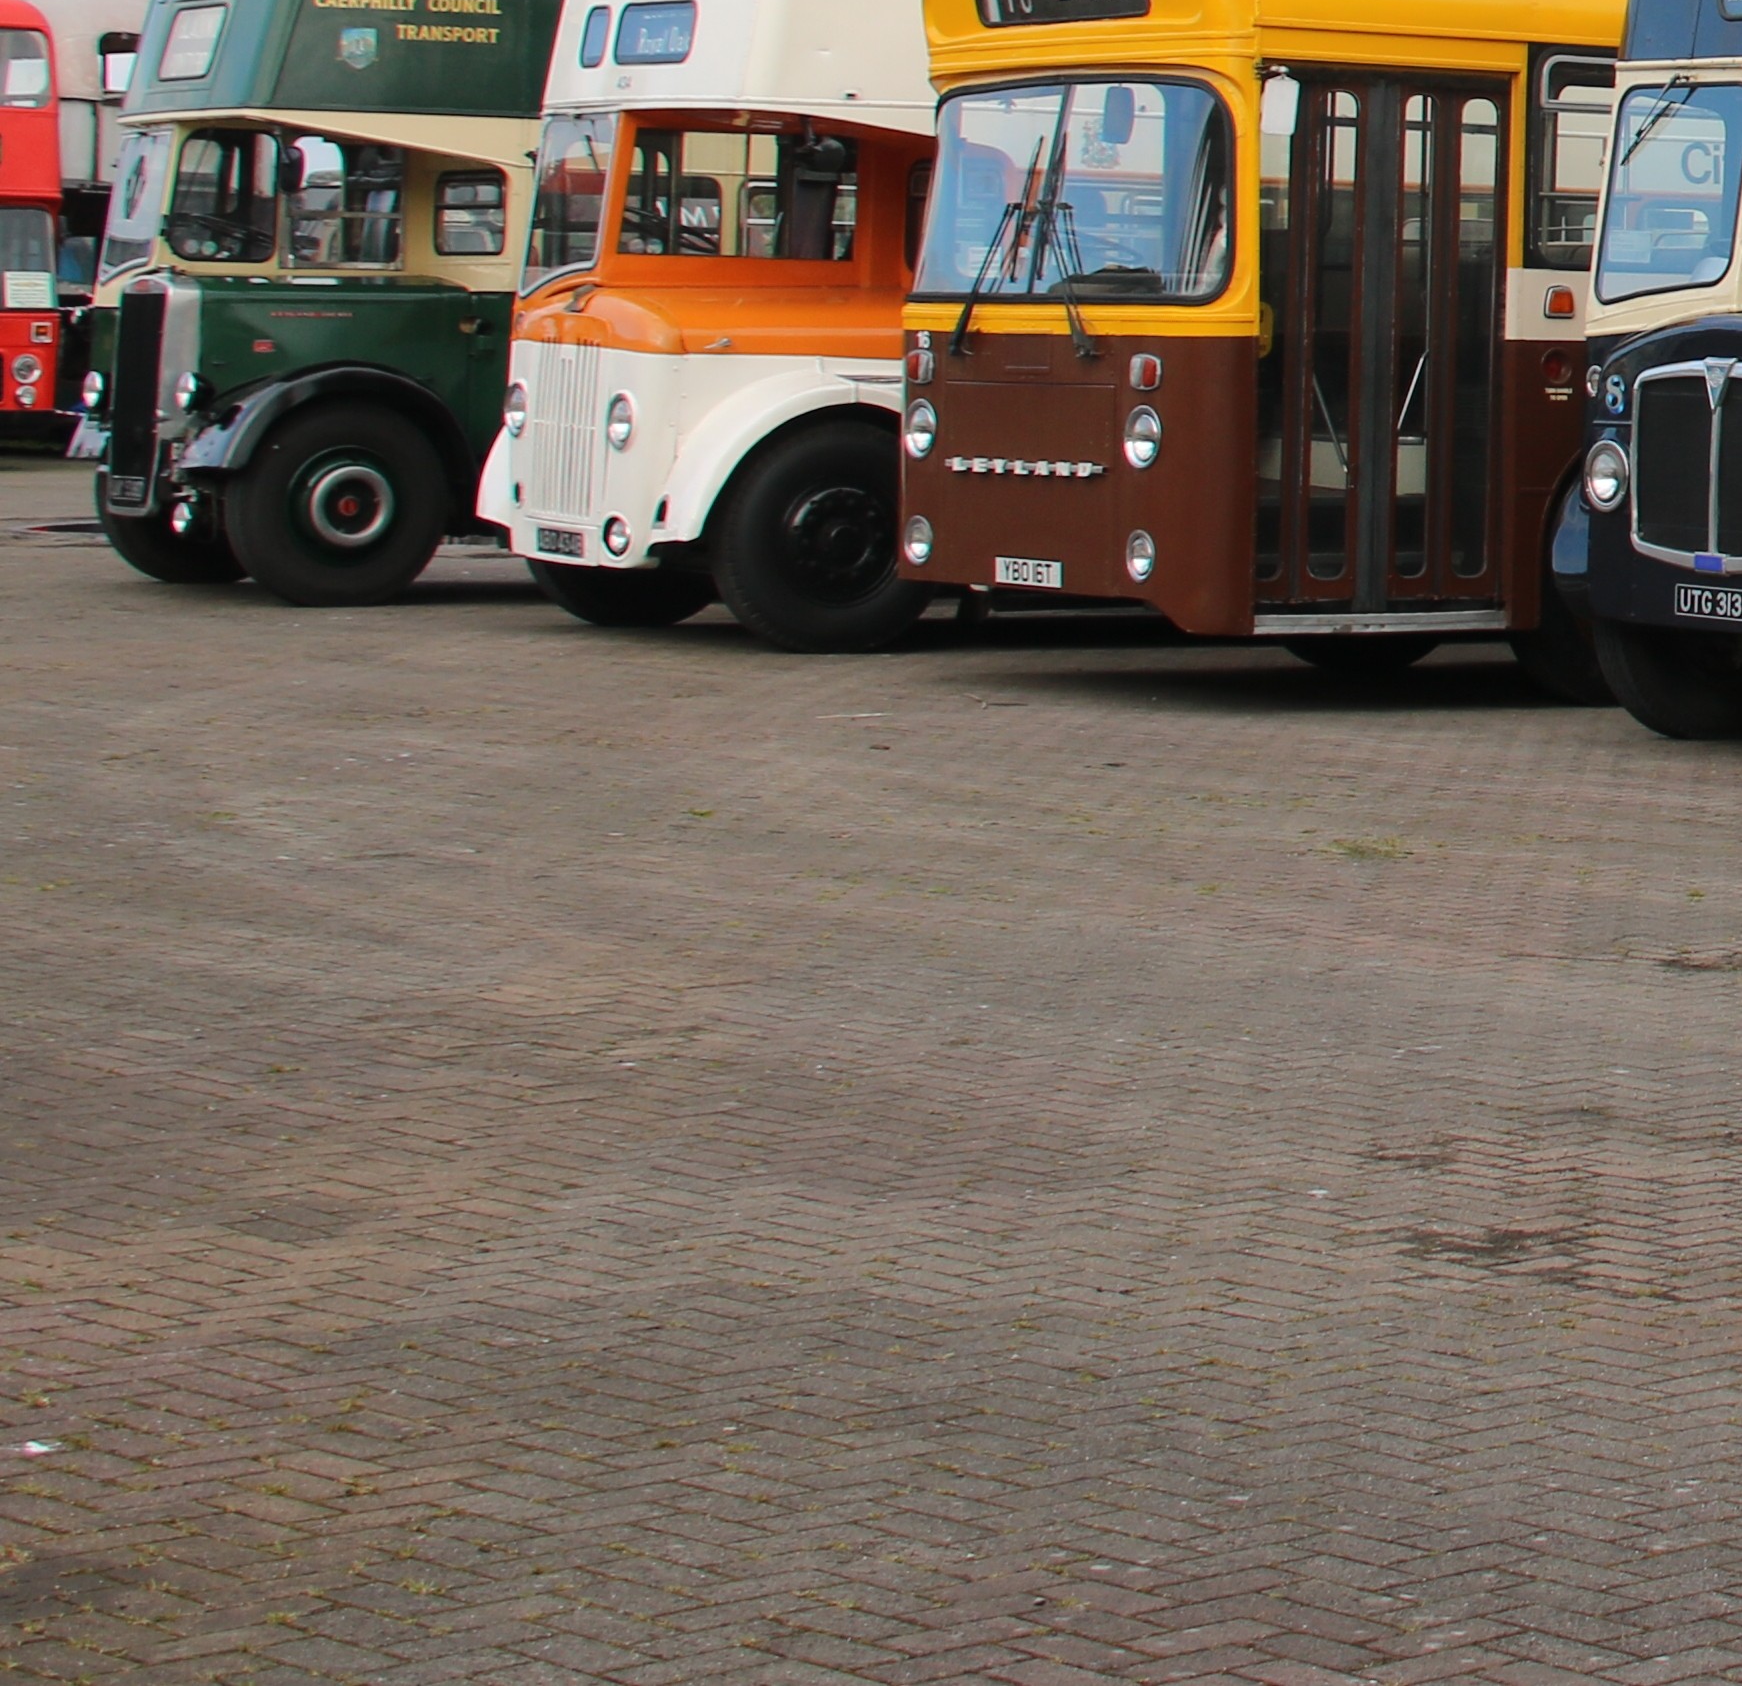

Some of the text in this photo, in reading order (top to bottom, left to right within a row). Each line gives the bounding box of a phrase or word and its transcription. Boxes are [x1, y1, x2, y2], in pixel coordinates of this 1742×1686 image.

[396, 24, 500, 44] TRANSPORT
[916, 330, 931, 349] 16
[951, 456, 1093, 478] LEYLAND
[1680, 588, 1713, 615] UTG
